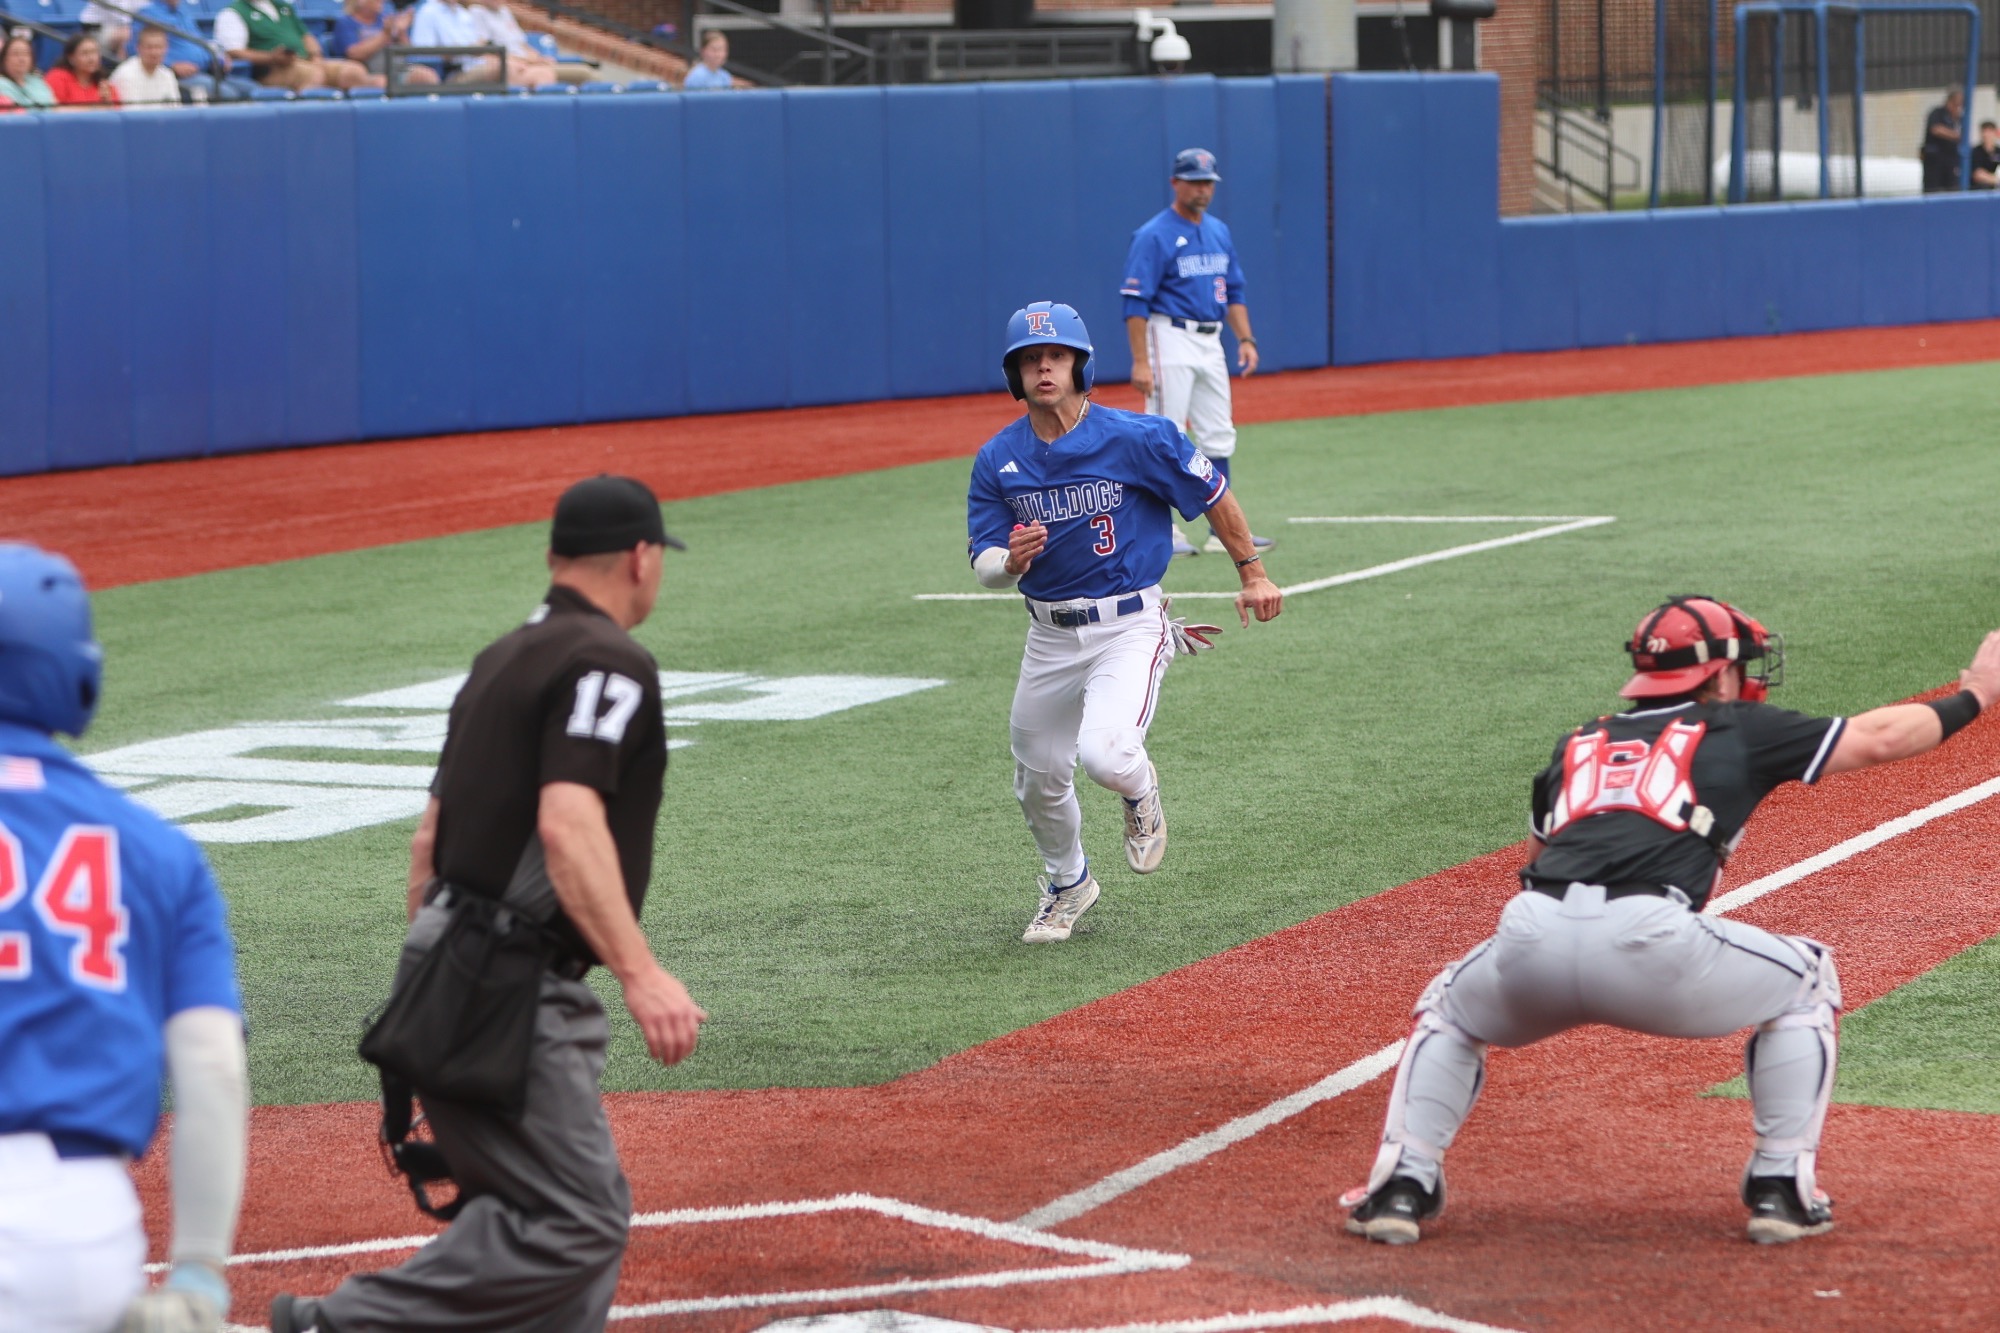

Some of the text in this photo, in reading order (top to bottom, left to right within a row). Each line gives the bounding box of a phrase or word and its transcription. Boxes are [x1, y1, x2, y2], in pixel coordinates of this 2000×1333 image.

[1213, 276, 1228, 303] 2
[1004, 480, 1123, 524] BULLDOGS
[1090, 513, 1116, 556] 3
[566, 670, 644, 744] 17
